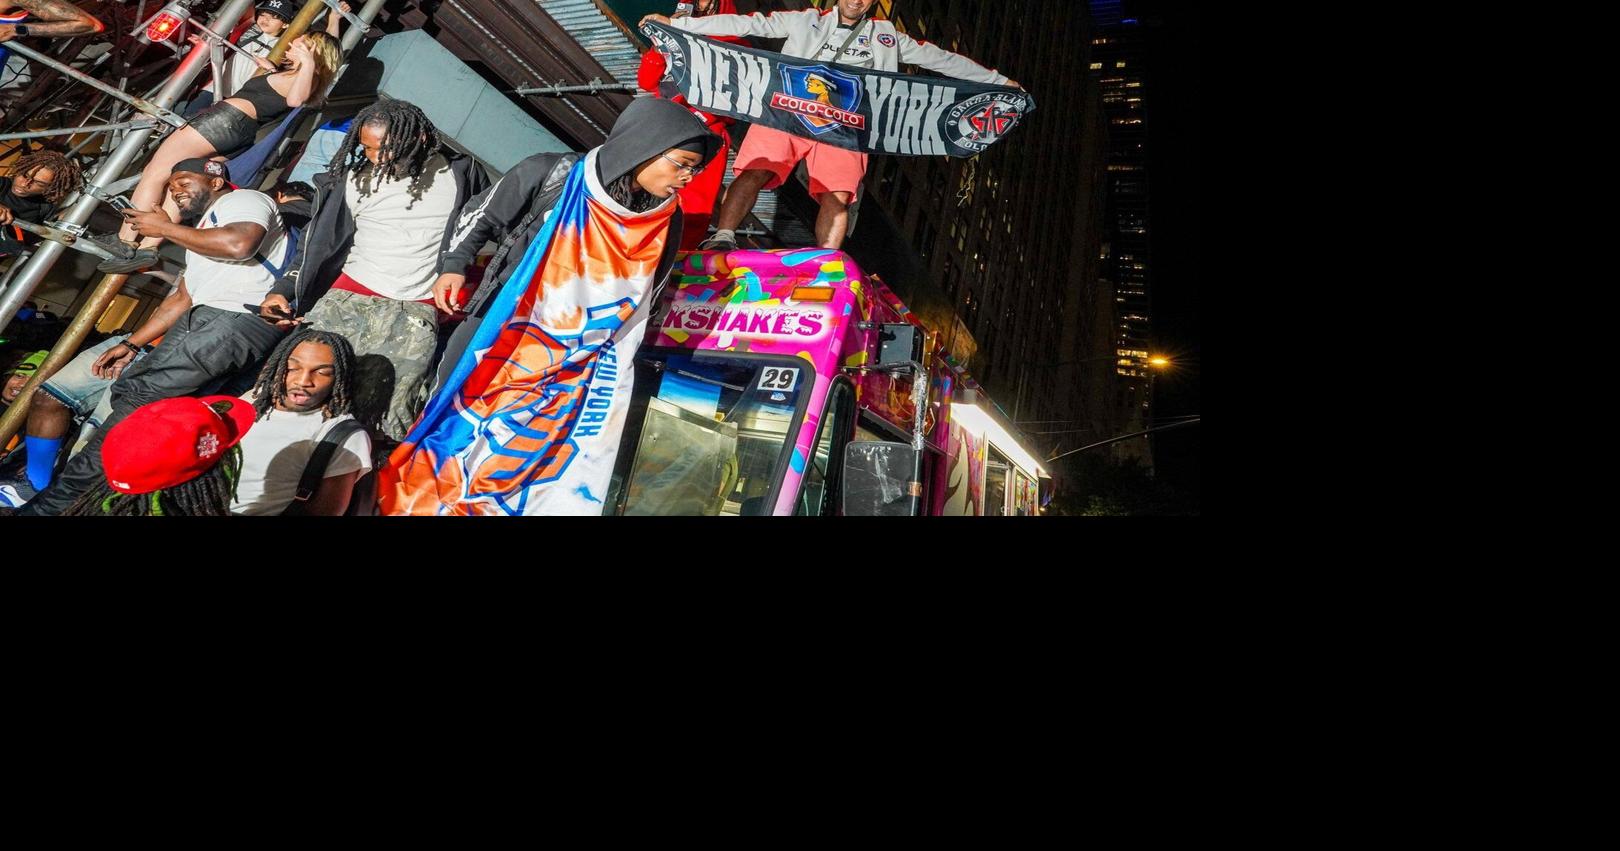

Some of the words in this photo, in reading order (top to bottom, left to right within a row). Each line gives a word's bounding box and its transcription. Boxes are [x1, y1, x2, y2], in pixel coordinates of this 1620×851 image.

[683, 33, 770, 118] NEW
[865, 75, 956, 155] YORK
[779, 96, 859, 124] COLO-COLO
[761, 368, 794, 389] 29
[573, 386, 616, 437] YORK
